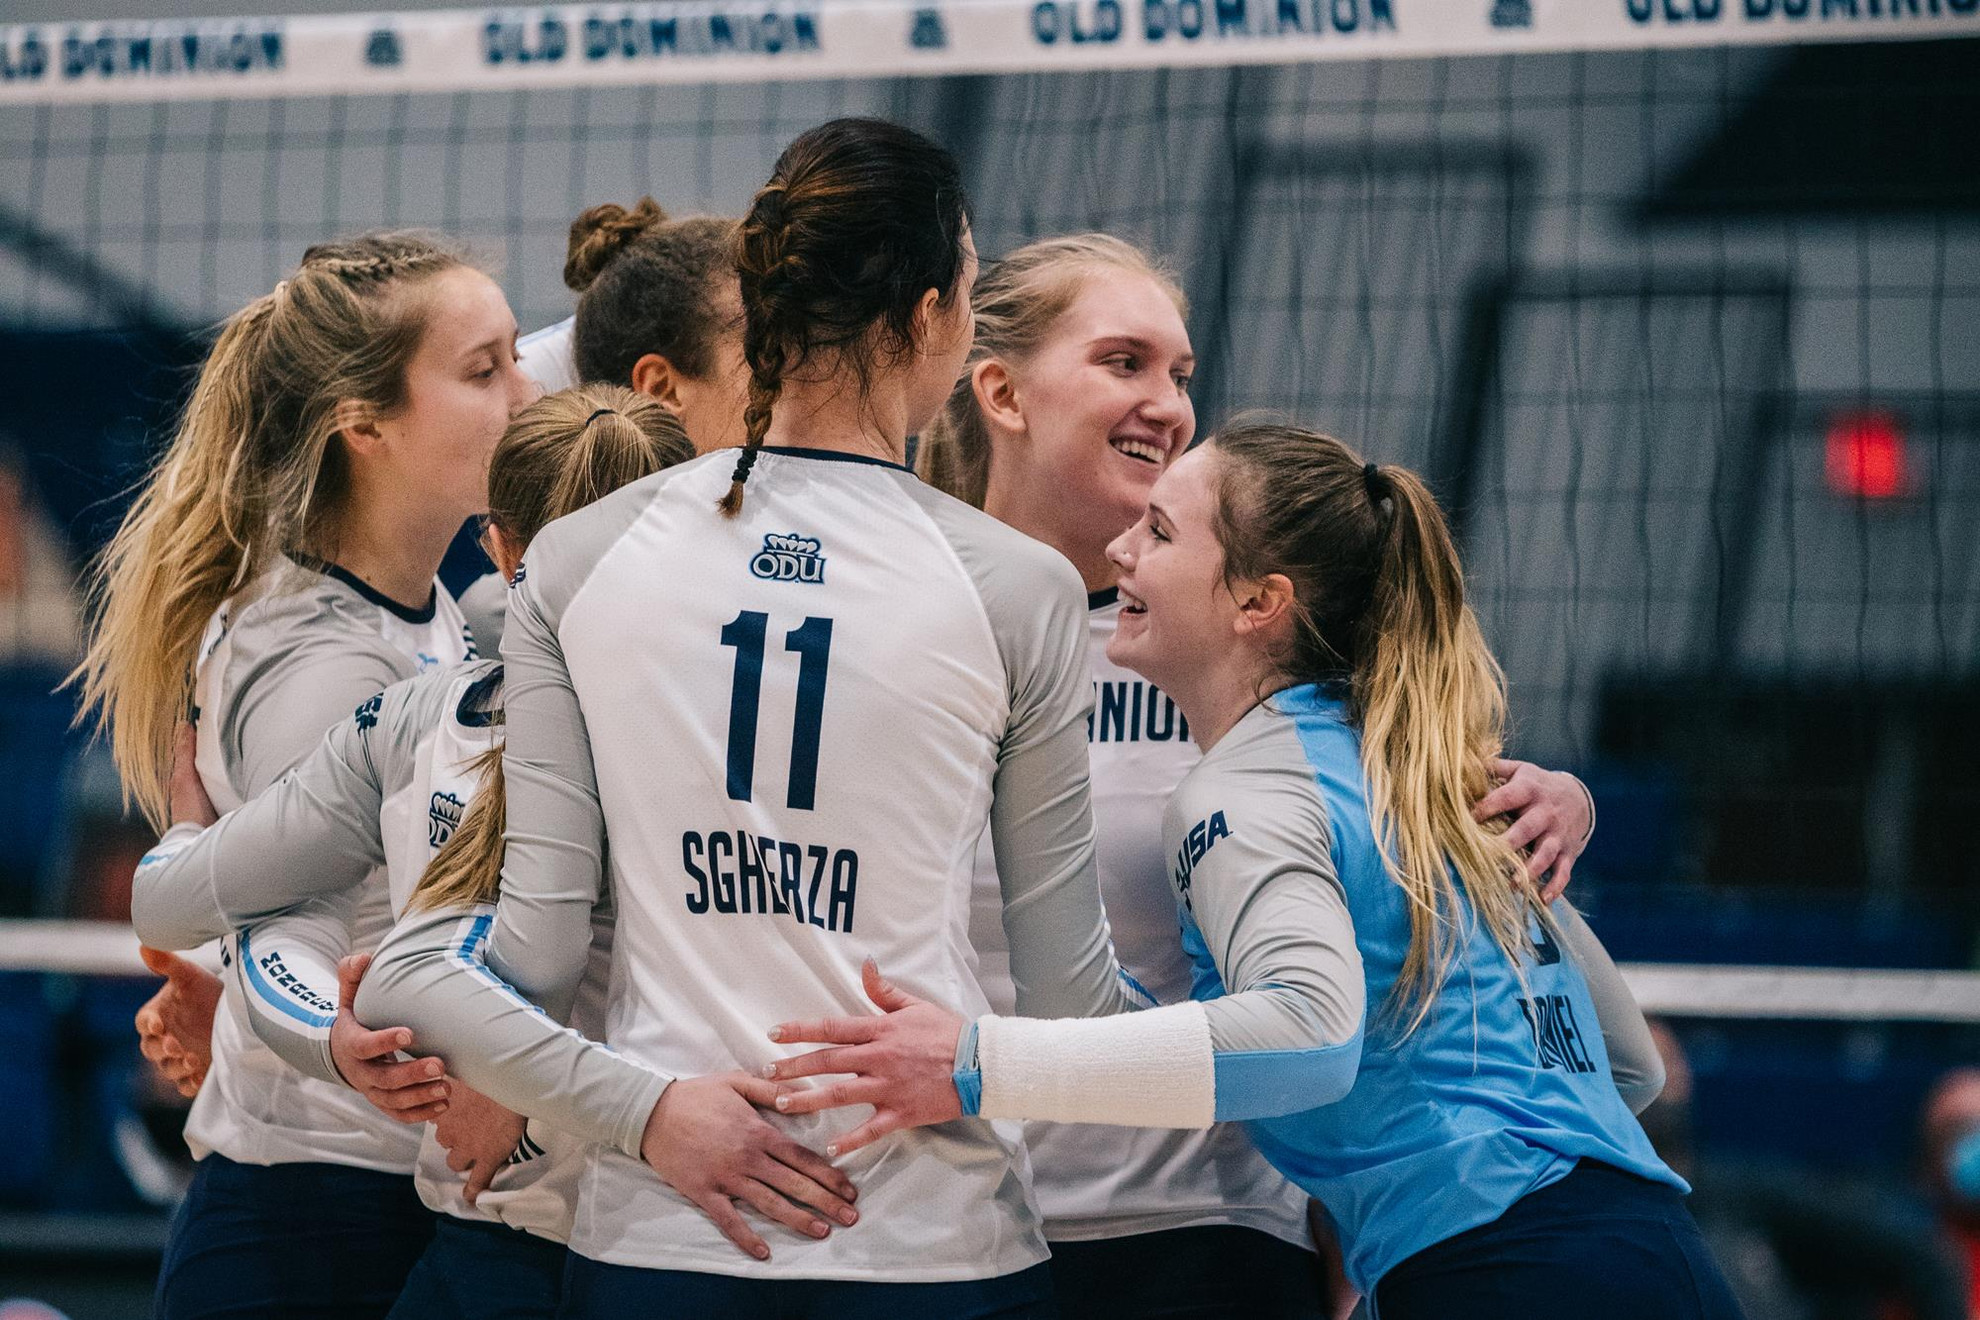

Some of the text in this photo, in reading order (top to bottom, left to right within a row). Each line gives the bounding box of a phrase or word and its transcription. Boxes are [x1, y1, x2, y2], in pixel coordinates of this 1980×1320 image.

[483, 13, 819, 63] OLD DOMINION
[1034, 0, 1397, 44] OLD DOMINION
[0, 30, 281, 80] LD DOMINION
[750, 551, 826, 584] ODU
[720, 609, 834, 811] 11
[682, 829, 859, 933] SGHERZA
